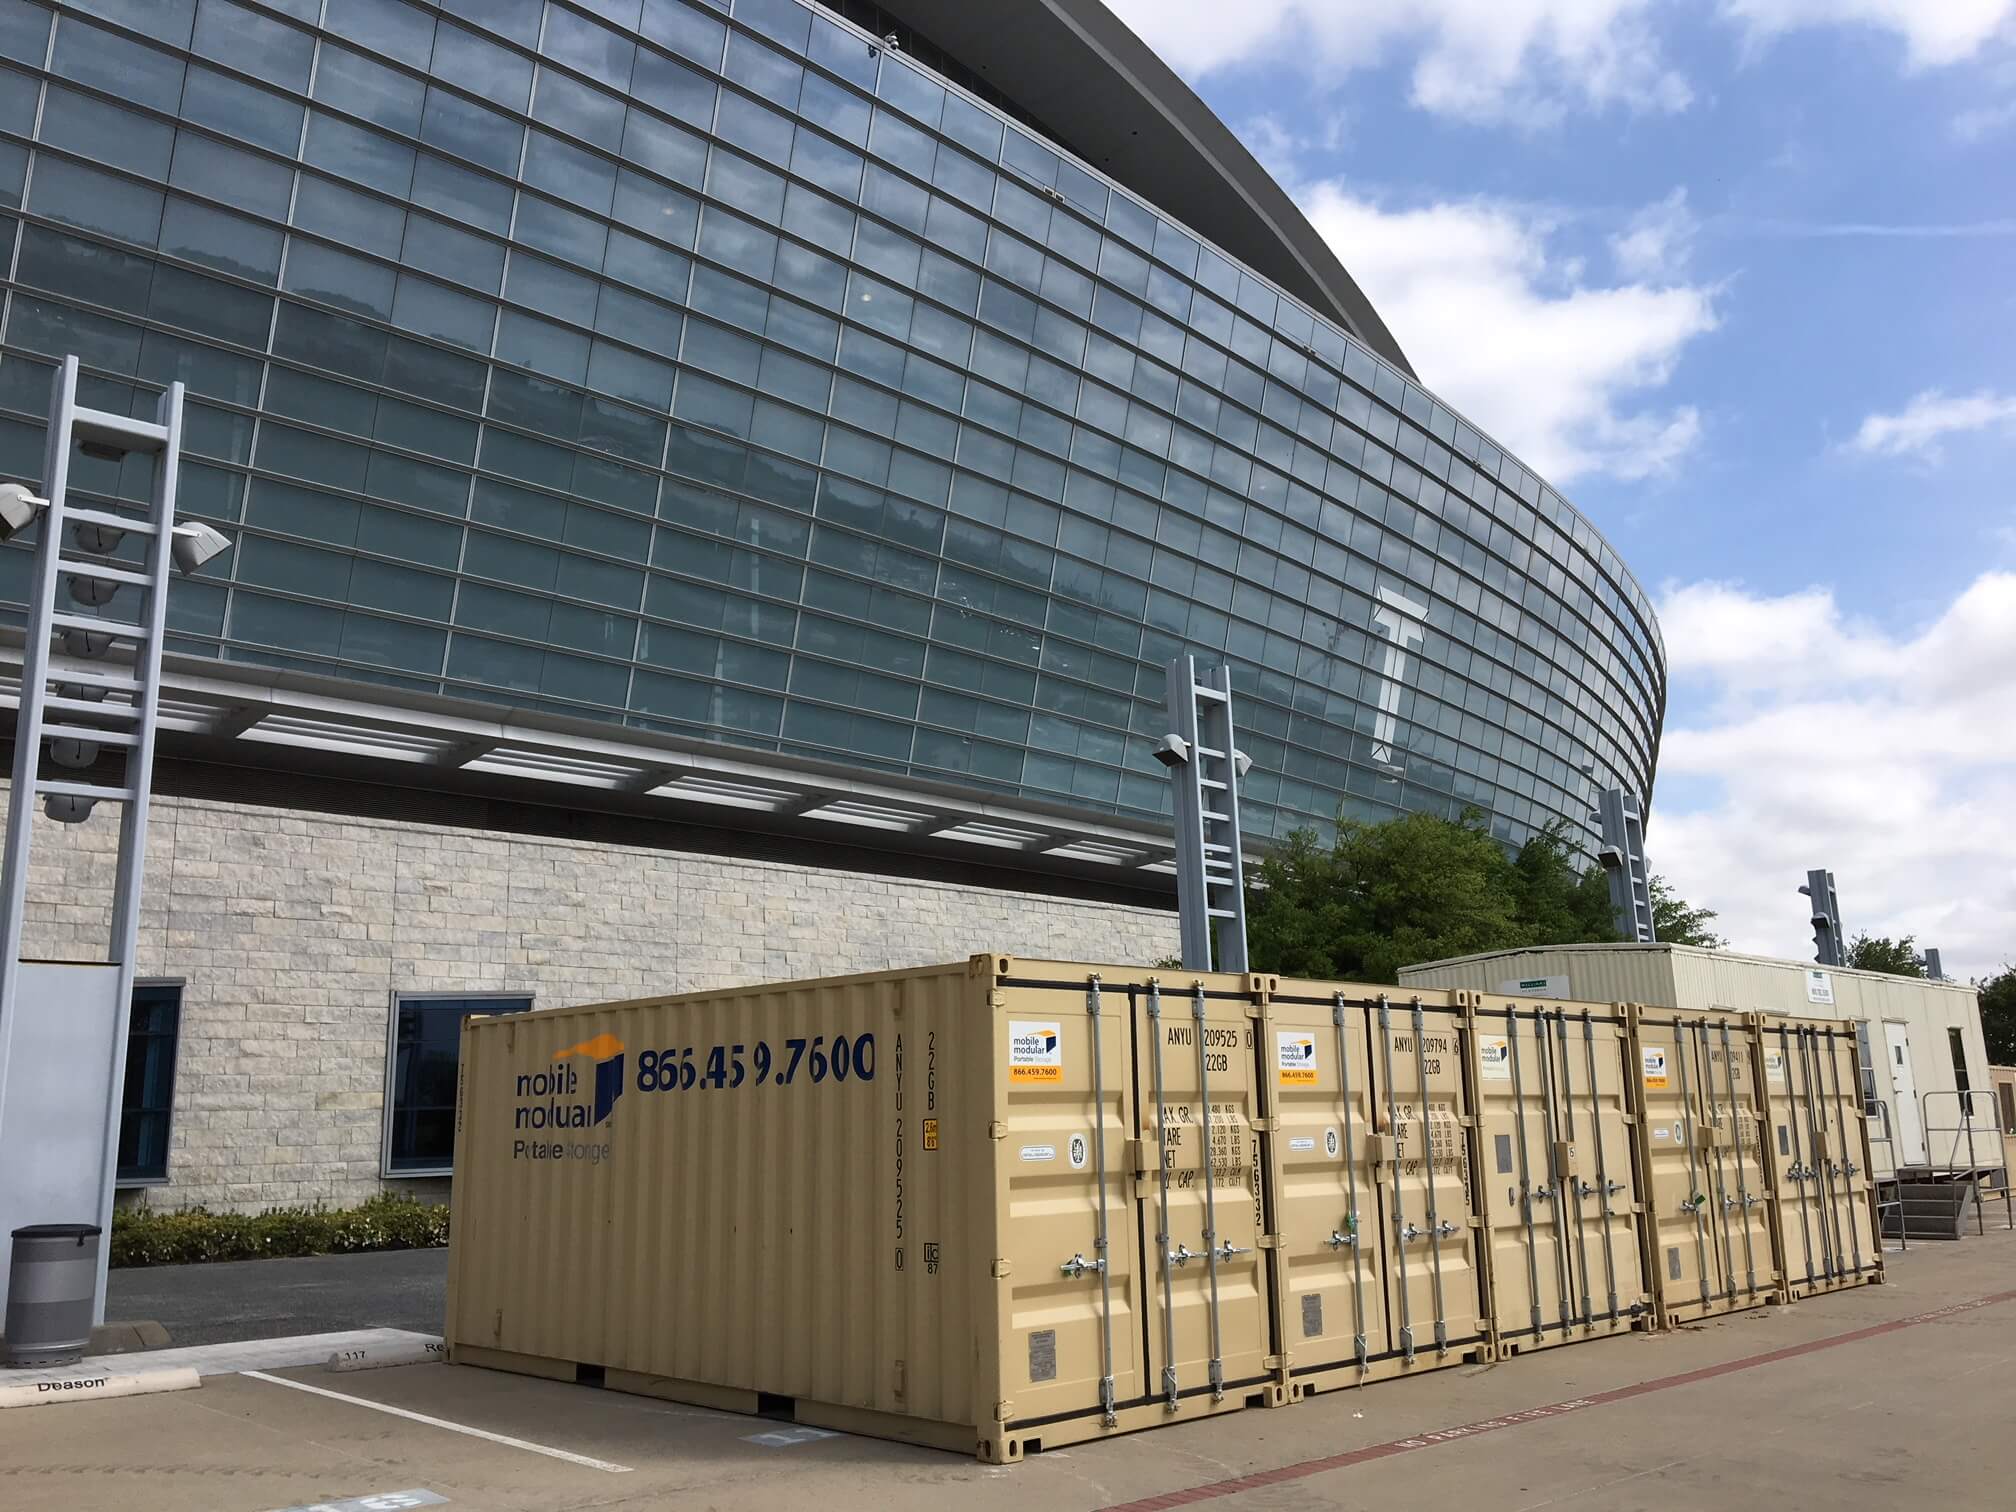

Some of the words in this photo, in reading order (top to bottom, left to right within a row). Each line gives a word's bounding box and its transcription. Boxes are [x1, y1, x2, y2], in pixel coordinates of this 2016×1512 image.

[1014, 1036, 1040, 1046] mobile
[1168, 1027, 1192, 1046] ANYU
[1204, 1029, 1238, 1048] 209525
[1395, 1036, 1413, 1053] ANYU
[1423, 1037, 1448, 1053] 209794
[1014, 1046, 1045, 1054] modular
[637, 1033, 876, 1092] 866.459.7600
[1205, 1054, 1228, 1071] 22GB
[1424, 1059, 1441, 1075] 22GB
[895, 1033, 903, 1111] ANYU
[1013, 1068, 1057, 1076] 866.459.7600
[1397, 1123, 1408, 1139] ARE
[344, 1351, 366, 1360] 117
[37, 1378, 106, 1393] Deason
